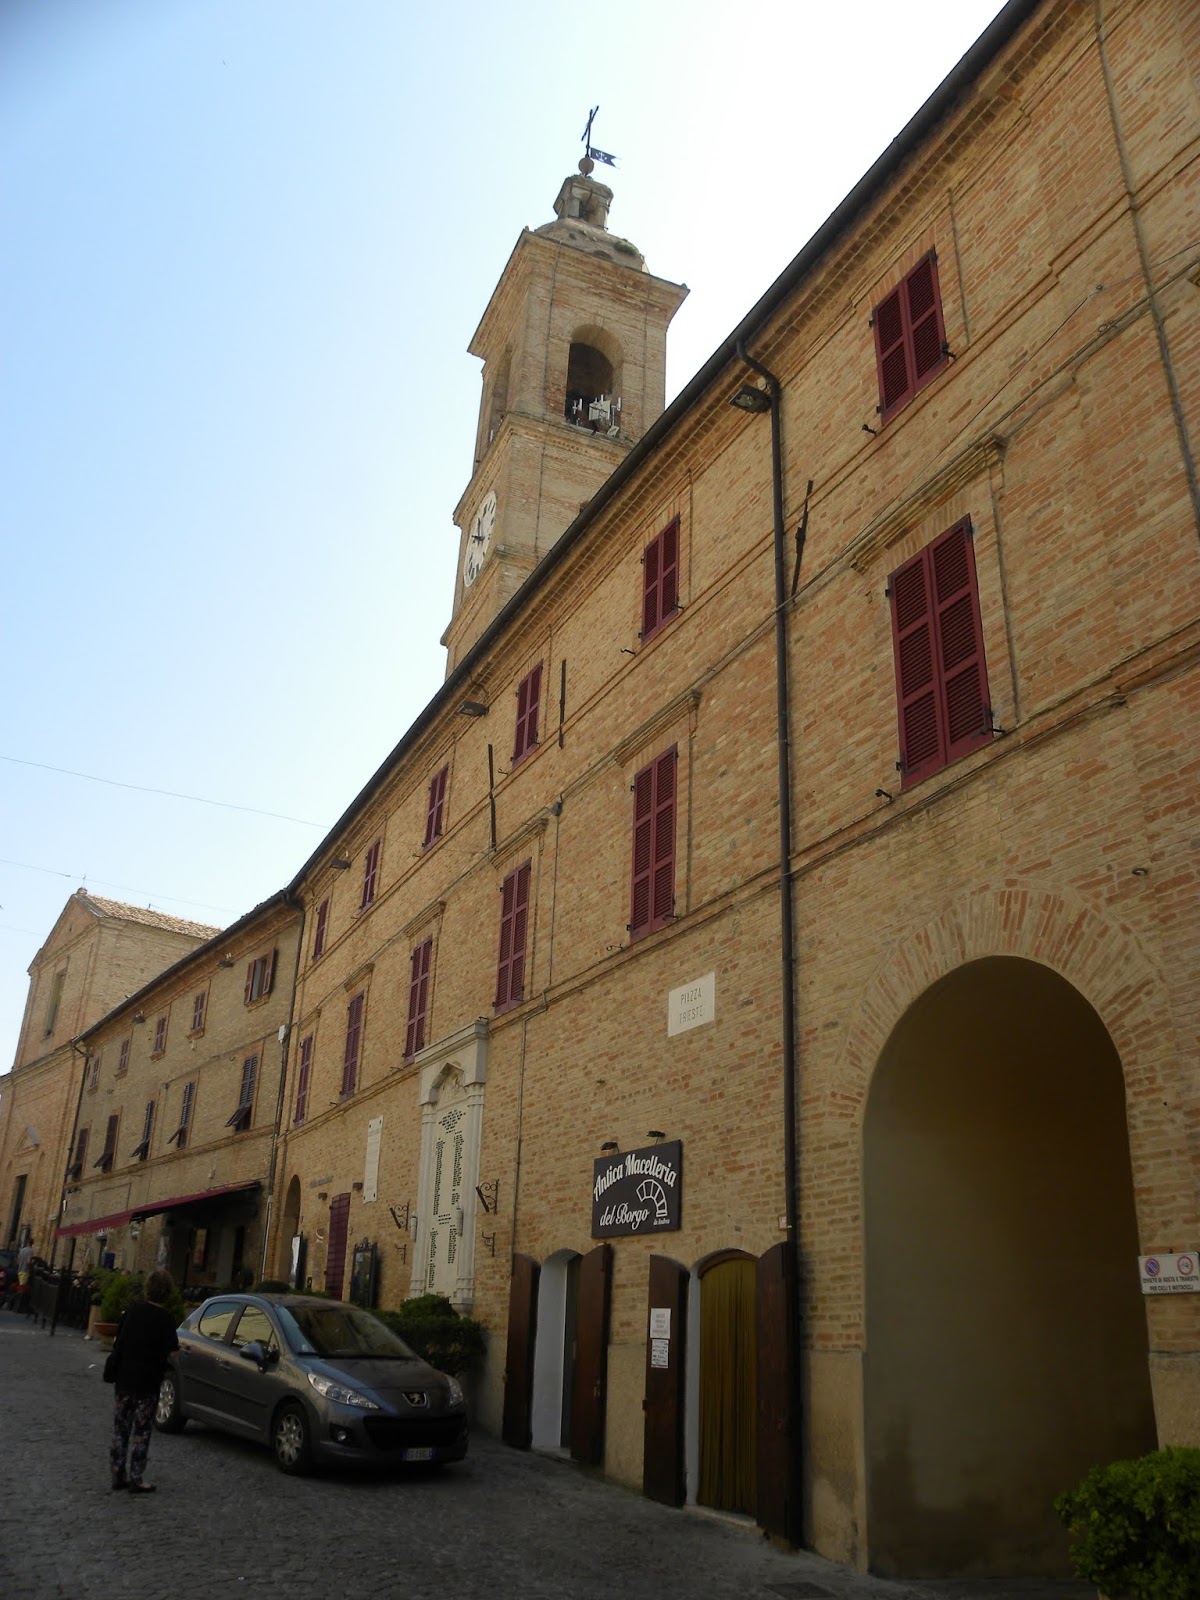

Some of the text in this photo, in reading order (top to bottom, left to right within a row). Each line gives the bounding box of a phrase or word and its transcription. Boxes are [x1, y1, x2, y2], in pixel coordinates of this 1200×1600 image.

[680, 987, 702, 1005] PIAZZA
[679, 1004, 704, 1024] TRIESTE
[593, 1153, 677, 1202] Antica Macelleria
[599, 1202, 650, 1230] del Borgo
